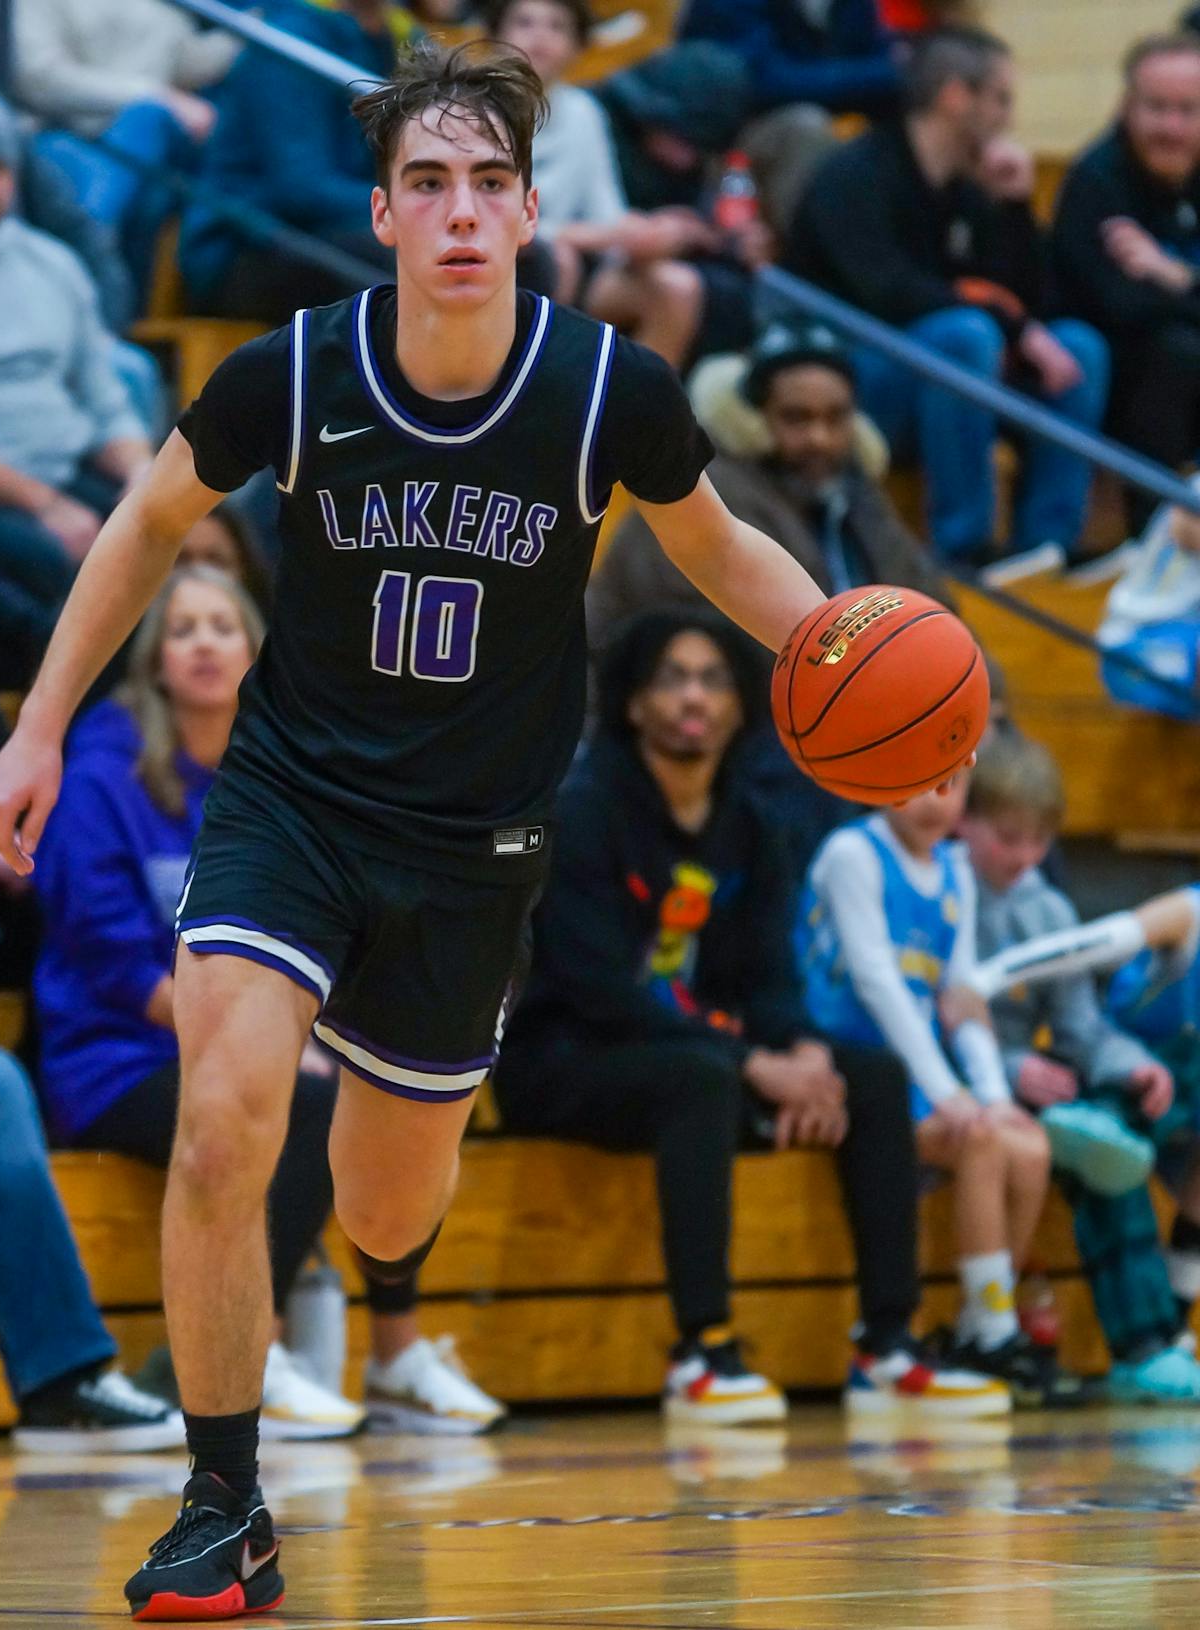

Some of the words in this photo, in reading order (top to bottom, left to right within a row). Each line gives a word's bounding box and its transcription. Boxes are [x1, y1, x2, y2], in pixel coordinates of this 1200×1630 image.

[316, 481, 559, 567] LAKERS
[371, 569, 484, 682] 10
[529, 834, 539, 847] M
